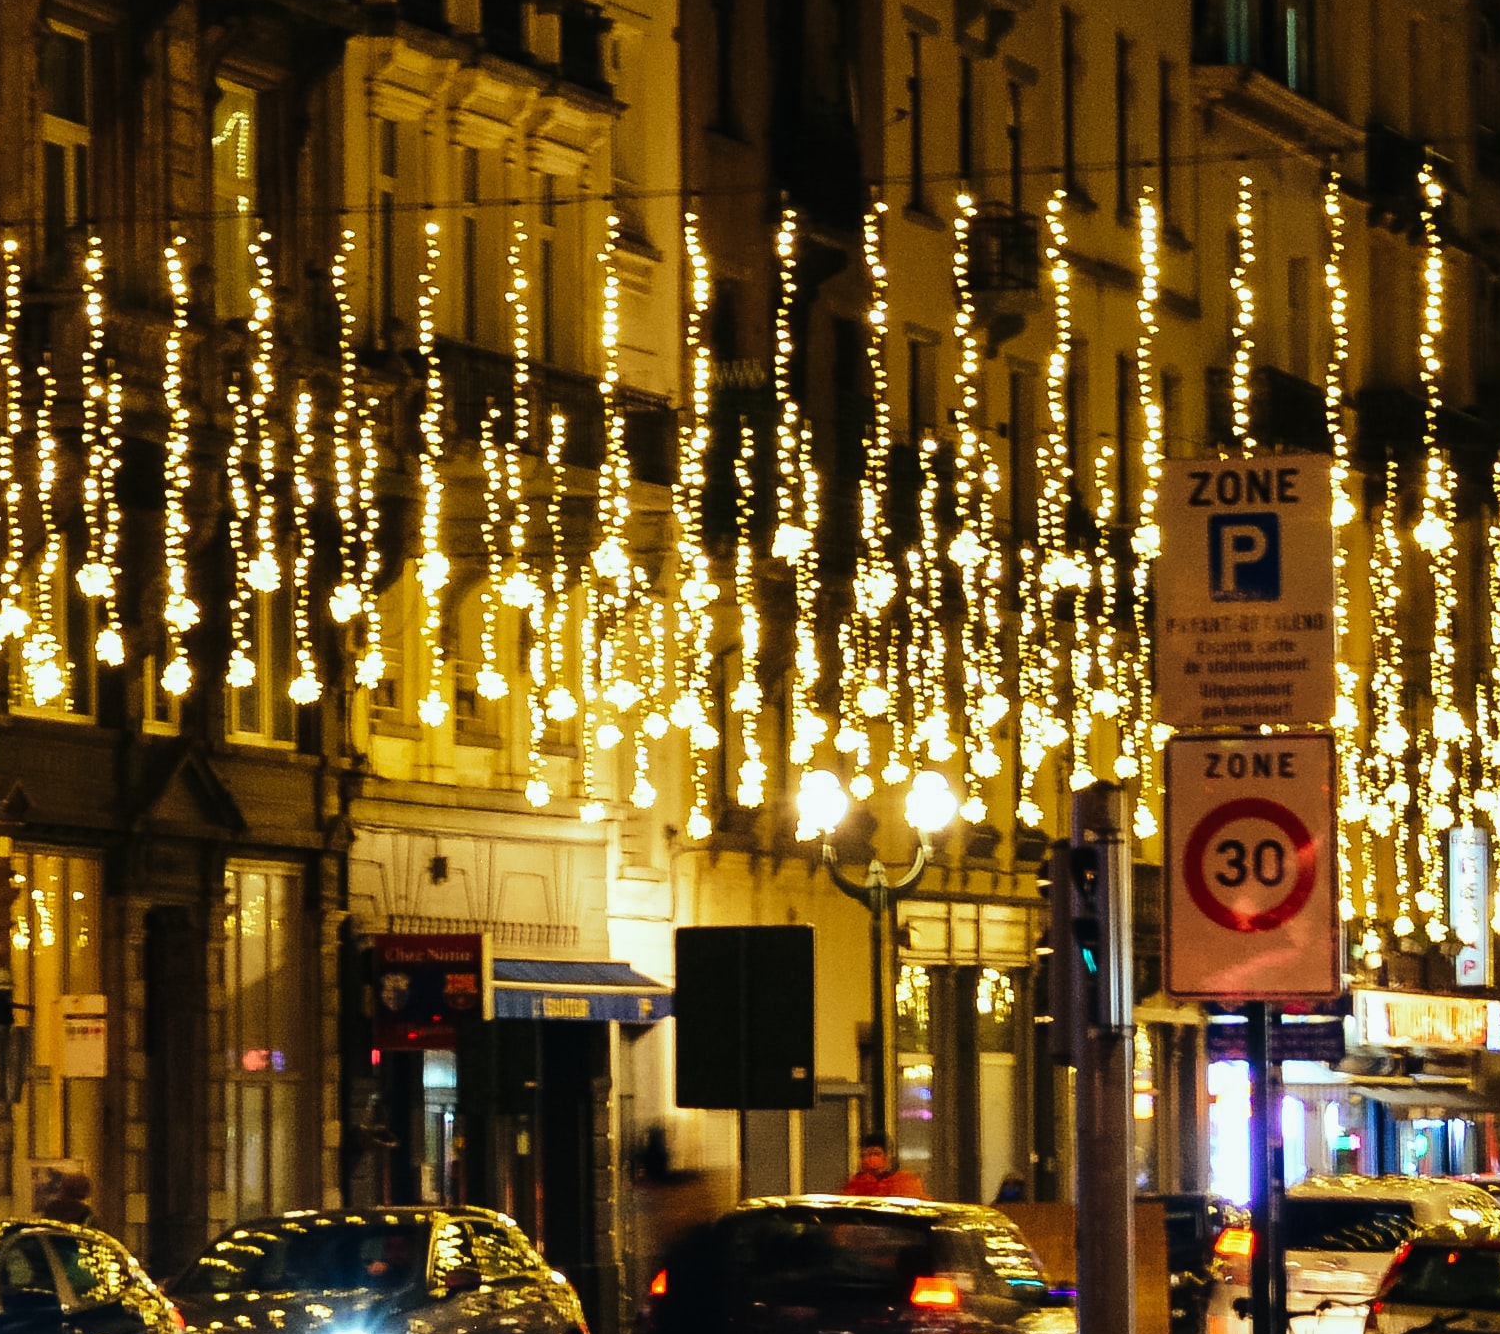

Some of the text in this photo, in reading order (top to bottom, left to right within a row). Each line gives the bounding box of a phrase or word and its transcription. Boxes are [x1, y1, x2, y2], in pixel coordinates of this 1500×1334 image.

[1187, 467, 1301, 508] ZONE
[1220, 524, 1267, 592] P
[1203, 751, 1297, 780] ZONE
[1215, 838, 1285, 887] 30
